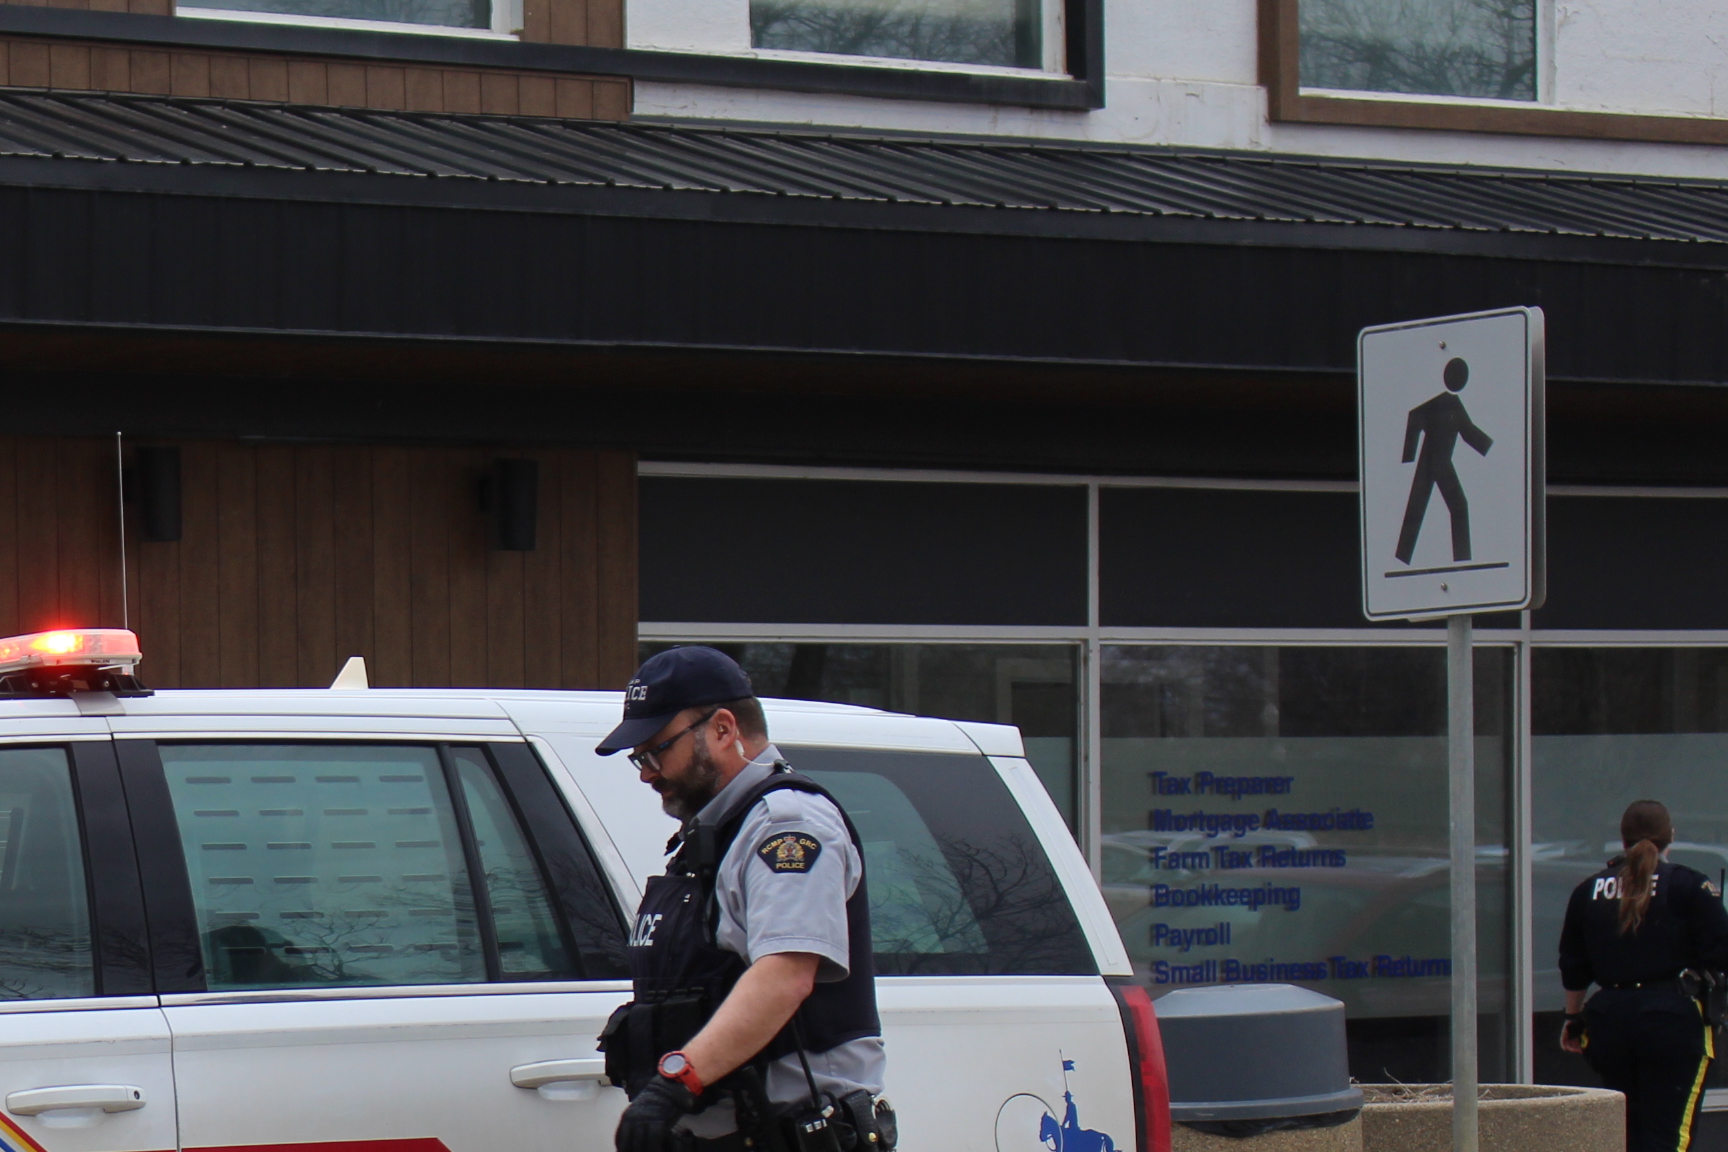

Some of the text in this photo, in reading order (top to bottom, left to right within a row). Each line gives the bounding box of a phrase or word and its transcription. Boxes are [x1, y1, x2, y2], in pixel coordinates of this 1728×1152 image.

[1149, 771, 1294, 800] Tax Preparer
[1149, 807, 1374, 838] Mortgage Associate
[761, 838, 817, 855] RCMP GRC
[1150, 845, 1346, 870] Farm Tax Returns
[1150, 882, 1300, 911] Bookkeeping
[1593, 874, 1659, 900] POLE
[1150, 922, 1231, 951] Payroll
[1152, 954, 1452, 984] Small Business Tax Return
